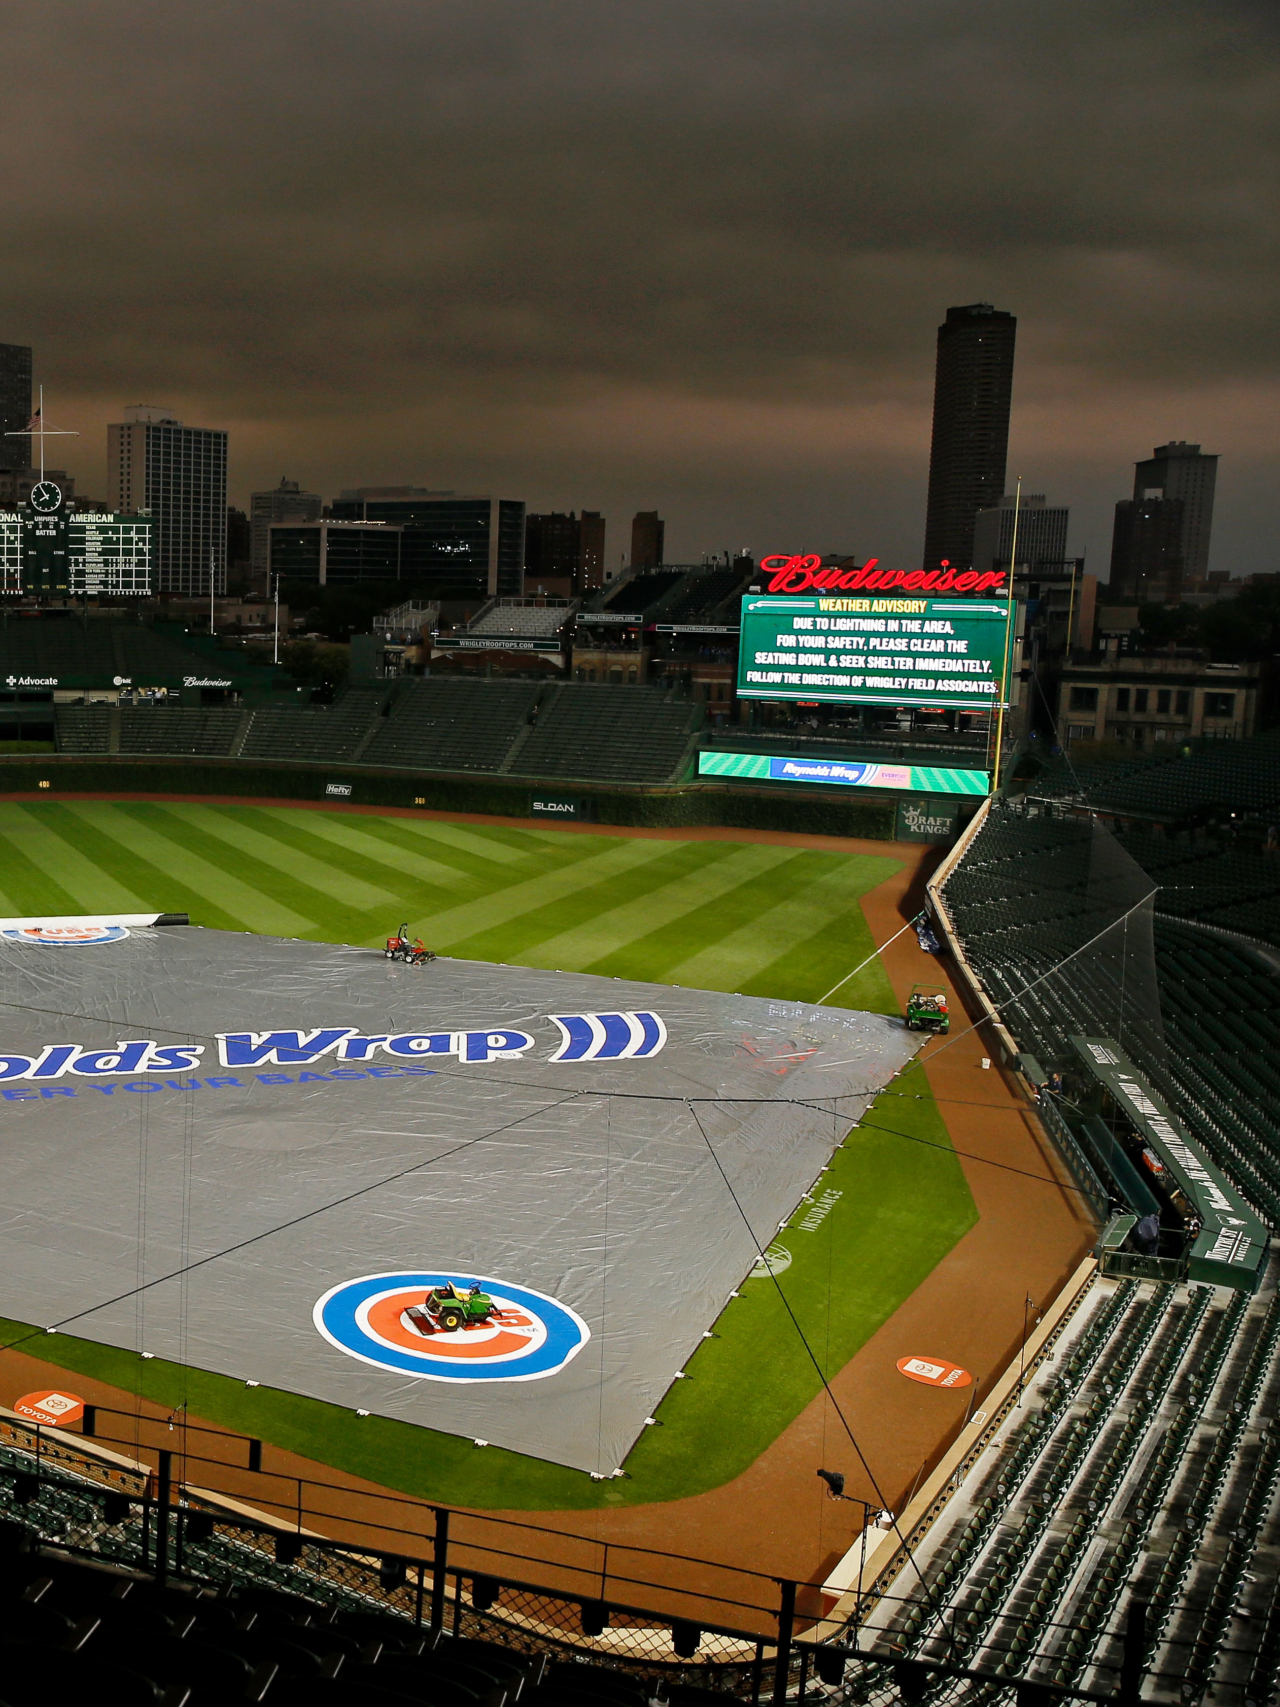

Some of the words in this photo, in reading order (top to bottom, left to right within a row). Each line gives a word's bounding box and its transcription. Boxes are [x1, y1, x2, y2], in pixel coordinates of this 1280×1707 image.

[69, 514, 114, 523] AMERICAN
[760, 554, 1006, 592] Budweiser
[818, 599, 870, 612] WEATHER
[872, 600, 927, 613] ADVISORY
[792, 618, 814, 630] DUE
[815, 618, 830, 631] TO
[830, 618, 886, 632] LIGHTNING
[887, 620, 900, 632] IN
[901, 620, 922, 632] THE
[922, 621, 954, 635] AREA,
[459, 640, 534, 650] WRIGLEYROOFTOPS.COM
[776, 635, 797, 648] FOR
[797, 635, 826, 649] YOUR
[827, 636, 868, 651] SAFETY,
[869, 638, 908, 651] PLEASE
[910, 639, 945, 652] CLEAR
[946, 640, 968, 653] THE
[754, 652, 797, 665] SEATING
[798, 653, 826, 666] BOWL
[828, 655, 838, 667] &
[838, 655, 866, 668] SEEK
[867, 656, 914, 670] SHELTER
[915, 658, 992, 673] IMMEDIATELY.
[18, 676, 58, 686] Advocate
[183, 676, 232, 687] Budweiser
[746, 671, 782, 684] FOLLOW
[783, 672, 801, 684] THE
[802, 673, 850, 686] DIRECTION
[851, 675, 864, 687] OF
[865, 676, 908, 690] WRIGLEY
[908, 678, 935, 690] FIELD
[935, 679, 999, 693] ASSOCIATES.
[782, 762, 830, 776] Reynolds
[830, 766, 859, 781] Wrap
[328, 786, 350, 794] Hefty
[533, 802, 575, 812] SLOAN
[905, 814, 952, 826] DRAFT
[910, 824, 950, 835] KINGS
[213, 1026, 536, 1069] Wrap
[83, 1075, 245, 1097] YOUR
[252, 1064, 438, 1087] BASES
[798, 1188, 843, 1232] INSURANCE
[1205, 1227, 1238, 1262] WINTRUST
[940, 1368, 964, 1386] TOYOTA
[18, 1405, 57, 1425] TOYOTA
